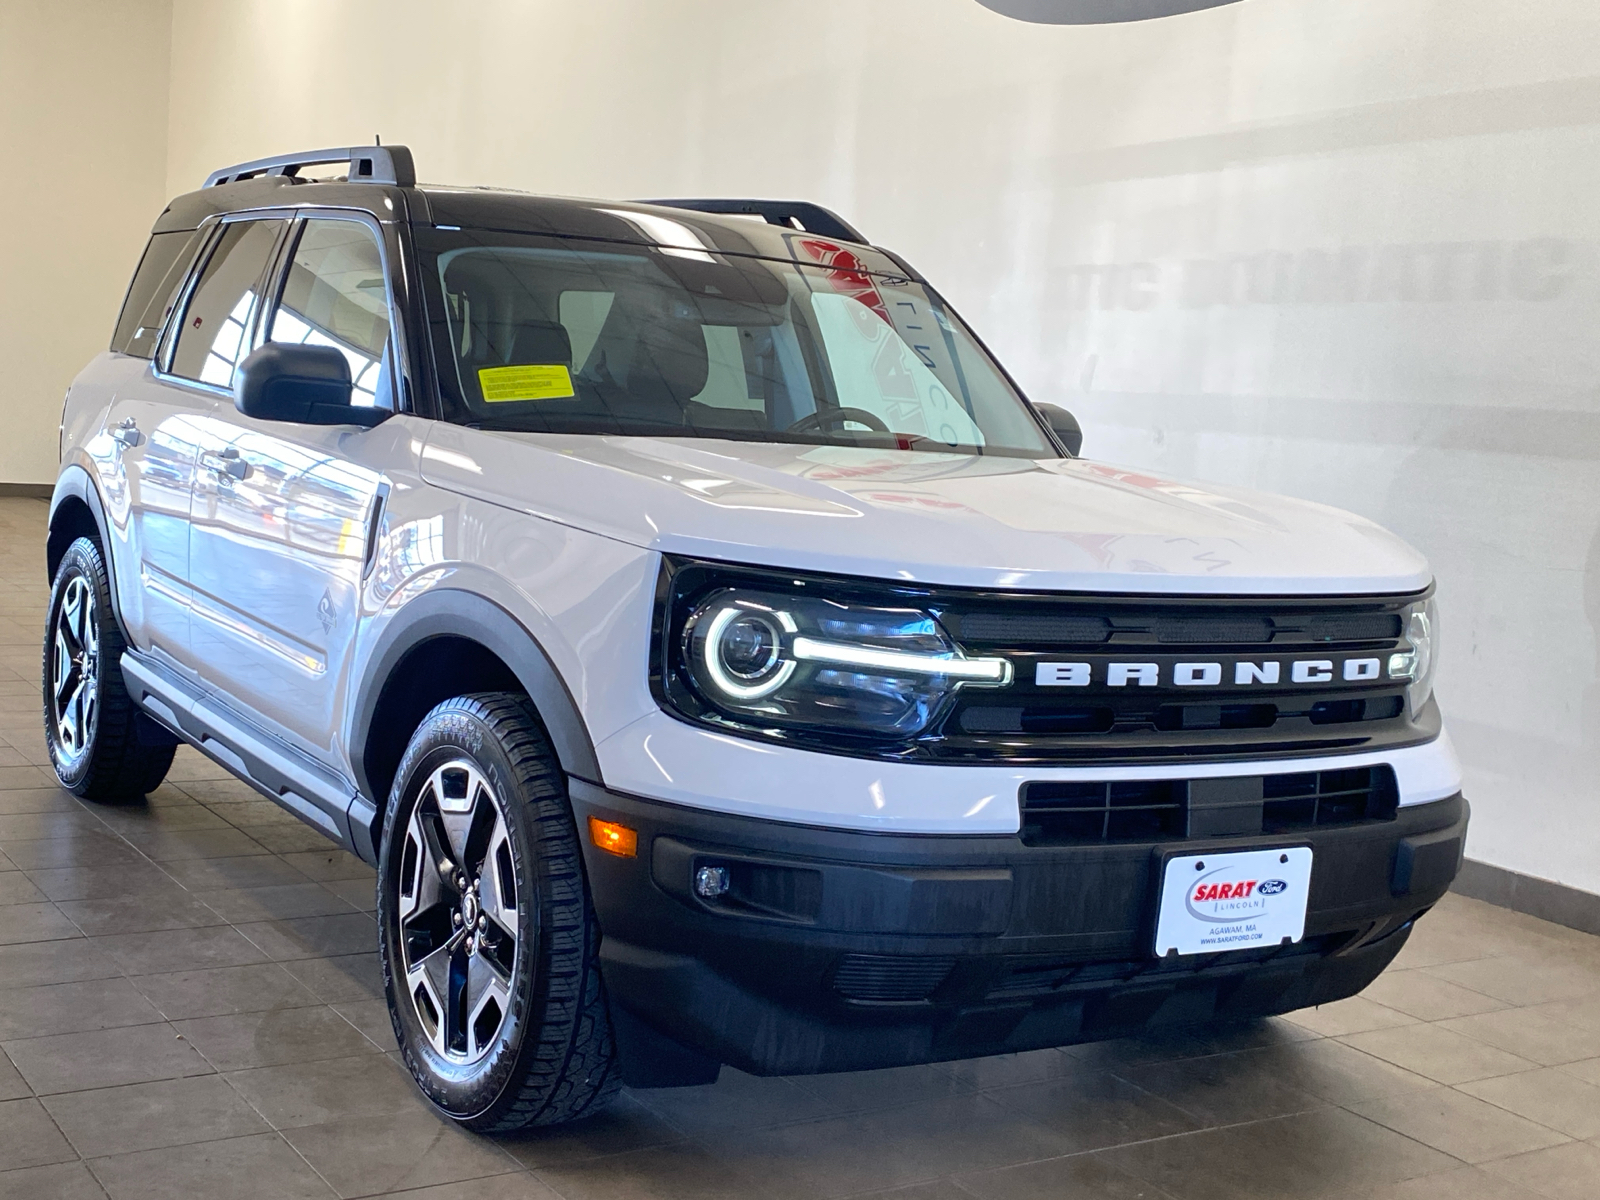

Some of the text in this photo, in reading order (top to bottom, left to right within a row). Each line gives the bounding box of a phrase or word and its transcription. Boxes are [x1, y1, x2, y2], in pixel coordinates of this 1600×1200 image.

[1035, 657, 1381, 687] BRONCO
[1194, 880, 1284, 901] SARAT Ford
[1221, 902, 1259, 910] LINCOLN
[1210, 926, 1243, 934] AGAWAM,
[1200, 934, 1263, 945] WWW.SARATFORD.COM
